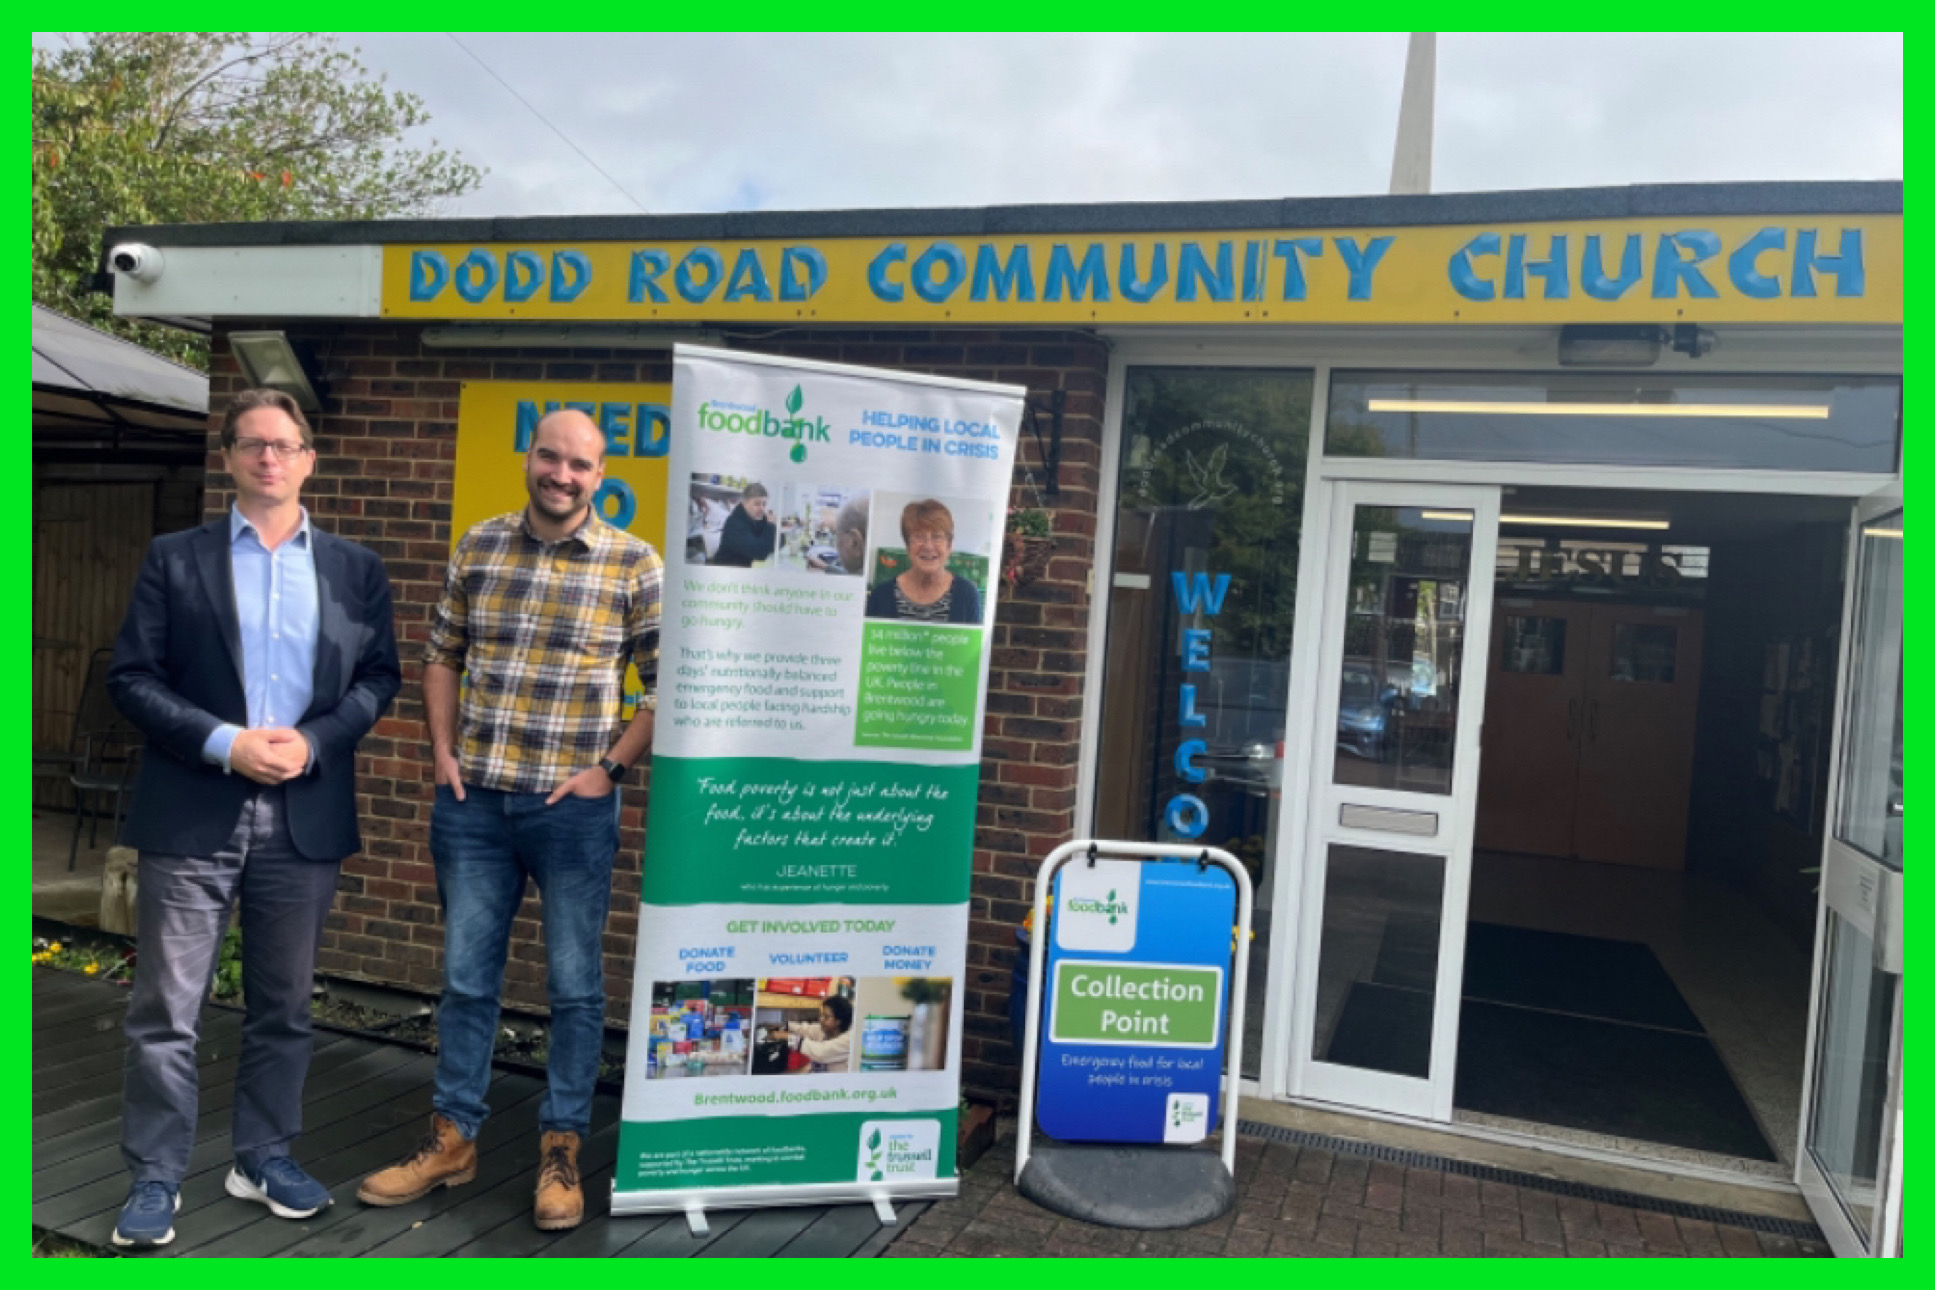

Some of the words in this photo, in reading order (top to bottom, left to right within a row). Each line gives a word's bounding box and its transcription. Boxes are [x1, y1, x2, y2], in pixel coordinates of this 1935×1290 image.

[409, 249, 593, 303] DODD
[628, 246, 828, 302] ROAD
[866, 236, 1396, 303] COMMUNITY
[1448, 227, 1866, 301] CHURCH
[698, 401, 831, 442] foodbank
[862, 410, 939, 432] HELPING
[943, 419, 1000, 439] LOCAL
[849, 429, 918, 451] PEOPLE
[922, 437, 941, 452] IN
[944, 440, 999, 459] CRISIS
[774, 586, 816, 600] anyone
[682, 599, 749, 614] community
[752, 602, 793, 615] should
[795, 604, 823, 615] have
[825, 606, 838, 617] to
[682, 616, 698, 628] go
[716, 650, 741, 663] why
[764, 650, 808, 665] provide
[810, 653, 842, 665] three
[784, 668, 837, 682] balanced
[676, 684, 742, 697] emergency
[744, 683, 773, 696] food
[774, 685, 798, 696] and
[800, 687, 845, 700] support
[691, 698, 718, 710] local
[720, 700, 762, 713] people
[764, 699, 800, 714] facing
[802, 702, 851, 716] hardship
[673, 715, 701, 727] who
[725, 716, 773, 728] referred
[739, 780, 799, 805] poverty
[801, 783, 816, 797] is
[821, 782, 844, 797] not
[837, 782, 876, 808] just
[880, 783, 922, 799] about
[925, 784, 949, 800] the
[781, 804, 824, 821] about
[828, 804, 851, 822] the
[856, 808, 935, 832] underlying
[733, 828, 789, 850] factors
[794, 829, 828, 846] that
[831, 830, 876, 847] create
[776, 864, 858, 878] JEANETTE
[726, 920, 759, 934] GET
[761, 920, 841, 934] INVOLVED
[843, 920, 897, 933] TODAY
[679, 945, 736, 960] DONATE
[769, 951, 849, 966] VOLUNTEER
[882, 945, 936, 957] DONATE
[686, 961, 726, 973] FOOD
[884, 959, 932, 970] MONEY
[1071, 974, 1204, 1002] Collection
[1101, 1010, 1169, 1035] Point
[1061, 1053, 1125, 1071] Emergency
[1128, 1054, 1154, 1069] food
[1157, 1055, 1176, 1070] for
[1177, 1057, 1204, 1070] local
[1088, 1073, 1125, 1087] people
[694, 1087, 897, 1107] Brentwood.foodbank.org.uk
[888, 1138, 909, 1151] the
